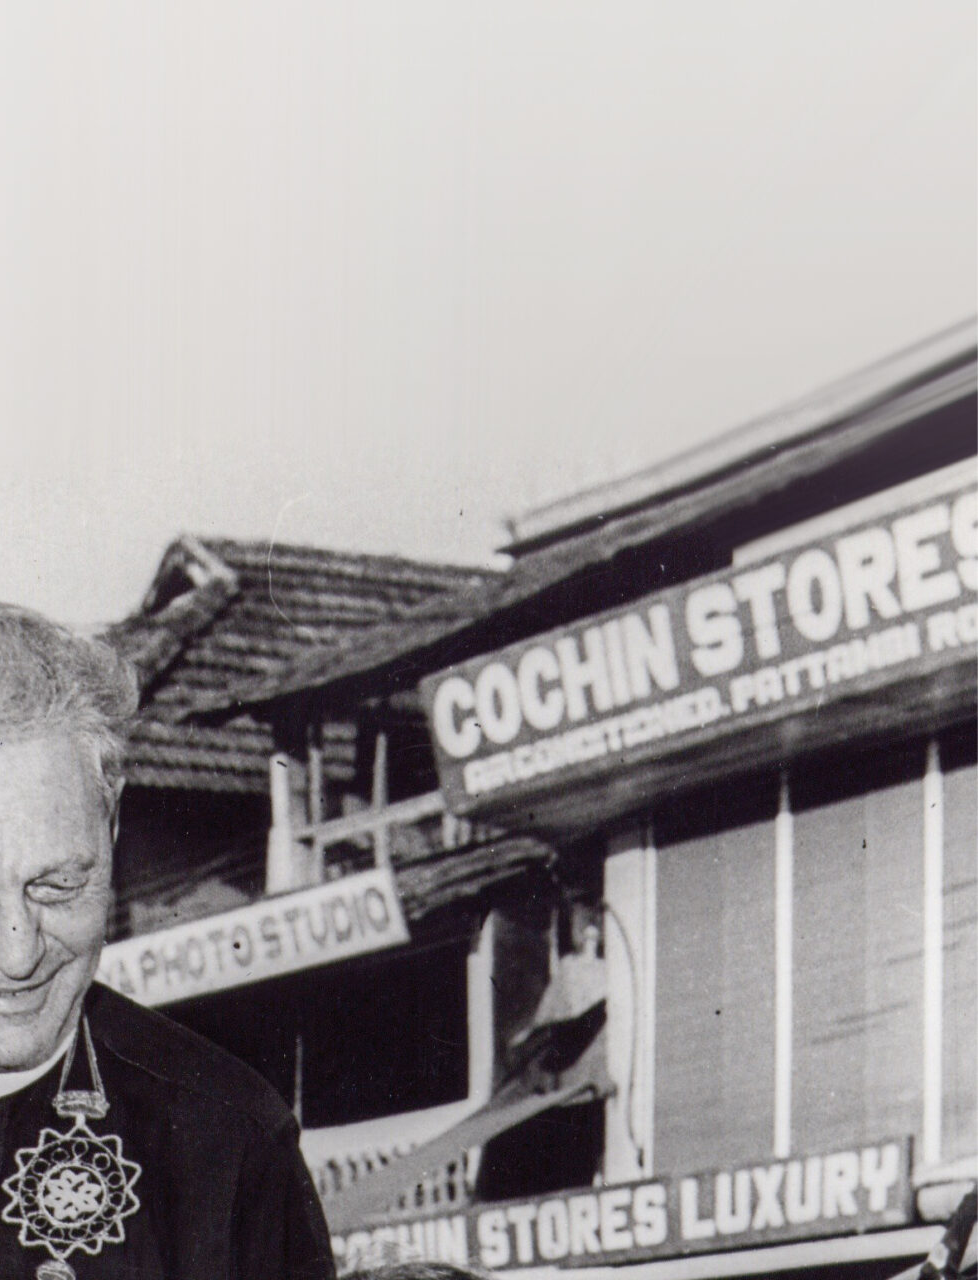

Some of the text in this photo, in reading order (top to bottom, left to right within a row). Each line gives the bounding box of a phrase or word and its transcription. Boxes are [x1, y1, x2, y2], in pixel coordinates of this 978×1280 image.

[432, 604, 680, 758] COCHIN
[140, 925, 253, 992] PHOTO
[259, 887, 389, 960] STUDIO
[477, 1185, 667, 1268] STORES
[681, 1145, 899, 1241] LUXURY
